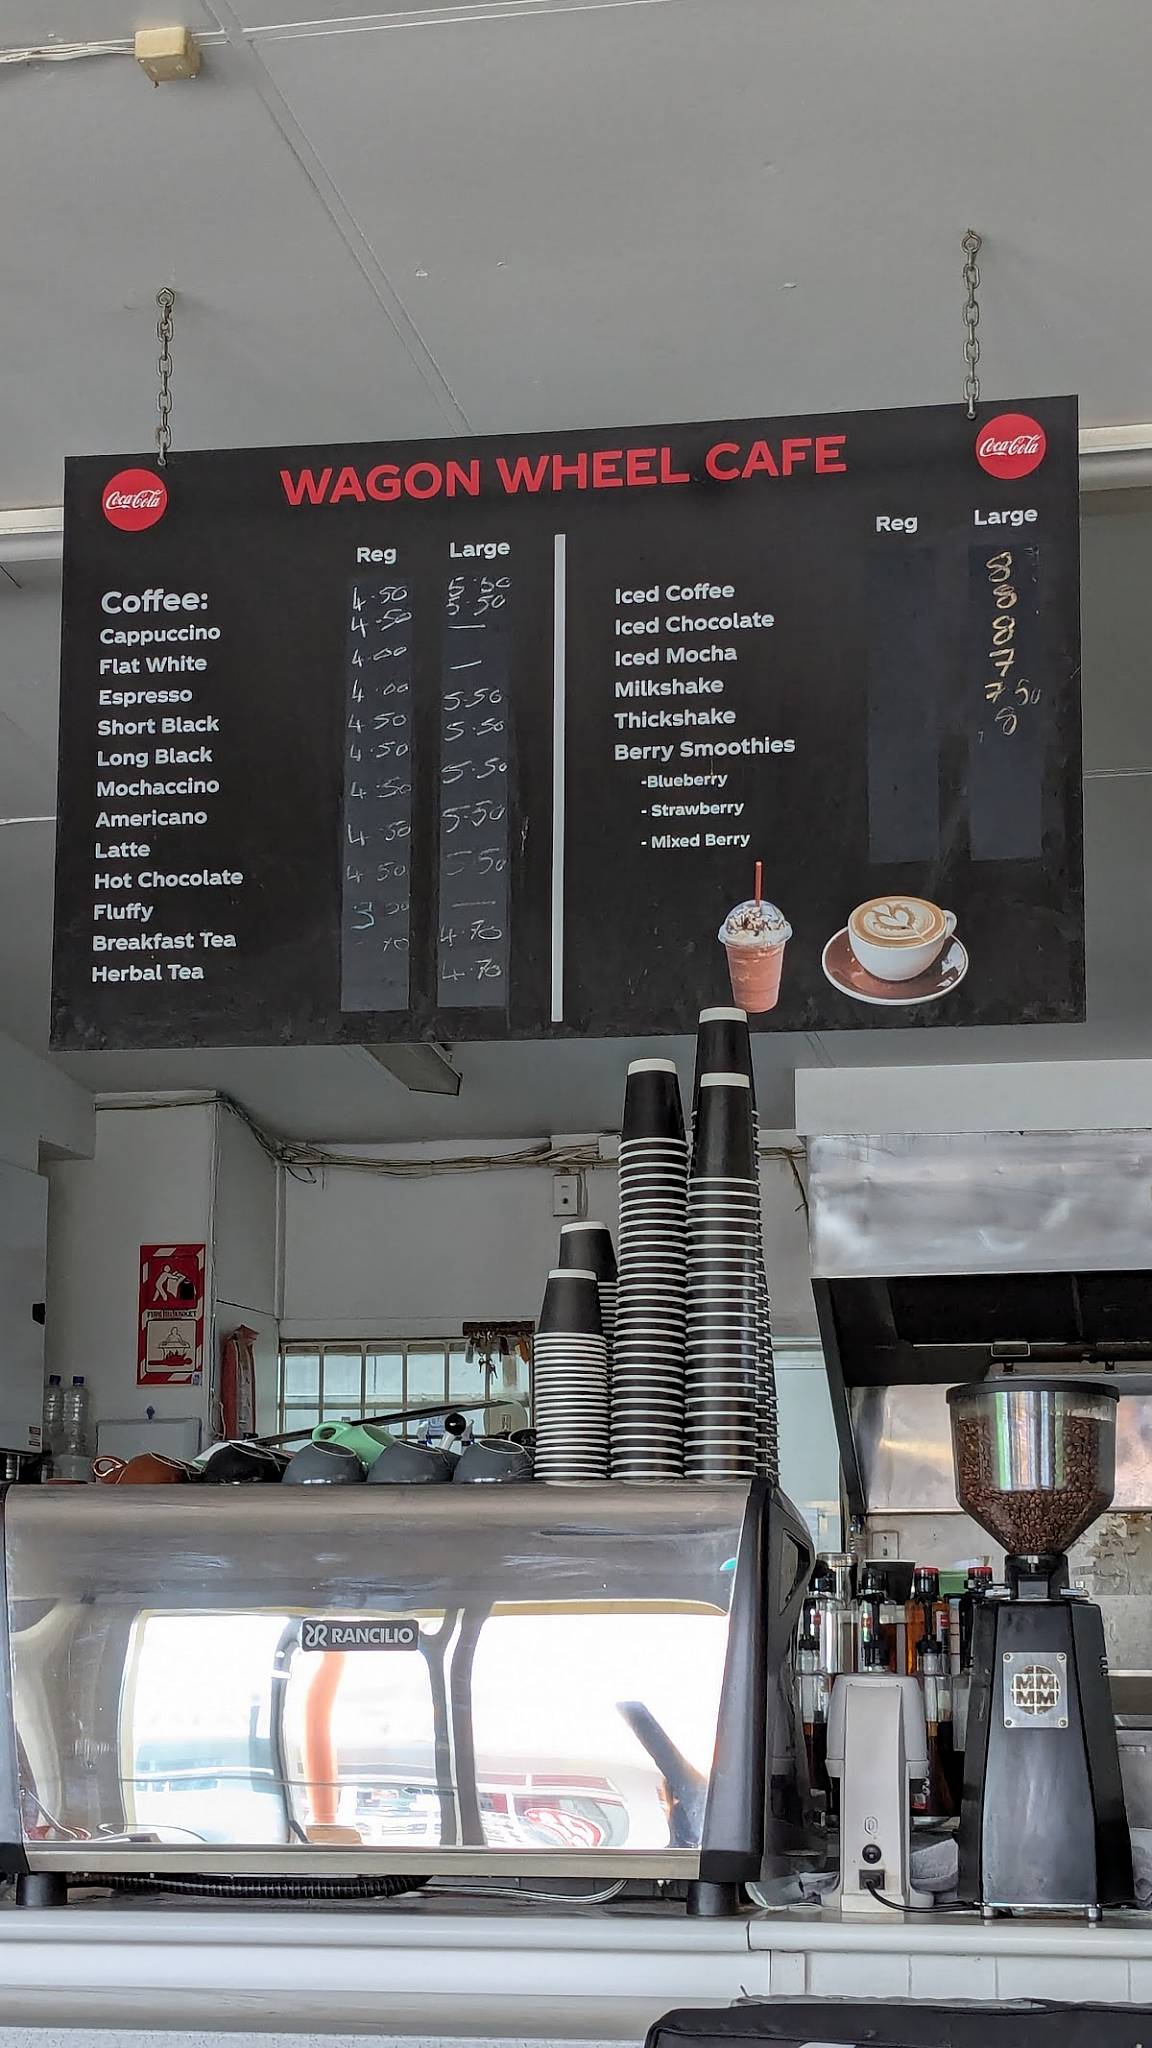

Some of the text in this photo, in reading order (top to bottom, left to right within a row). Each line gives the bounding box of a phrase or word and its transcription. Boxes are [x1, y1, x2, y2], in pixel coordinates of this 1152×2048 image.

[279, 435, 847, 506] WAGON WHEEL CAFE
[876, 515, 918, 534] Reg
[974, 508, 1039, 527] Large
[356, 546, 398, 565] Reg
[449, 541, 511, 560] Large
[101, 588, 208, 614] Coffee:
[615, 582, 735, 605] Iced Coffee
[615, 611, 775, 636] Iced Chocolate
[992, 615, 1016, 646] 8
[99, 624, 221, 647] Cappuccino
[99, 655, 208, 675] Flat White
[615, 645, 738, 667] Iced Mocha
[989, 648, 1015, 678] 7
[614, 677, 724, 698] Milkshake
[99, 689, 193, 708] Espresso
[97, 715, 220, 736] Short Black
[614, 707, 736, 730] Thickshake
[97, 746, 213, 768] Long Black
[614, 736, 796, 762] Berry Smoothies
[96, 777, 220, 797] Mochaccino
[95, 809, 208, 828] Americano
[651, 801, 745, 817] Strawberry
[95, 841, 151, 859] Latte
[651, 834, 701, 849] Mixed
[705, 833, 751, 848] Berry
[94, 868, 244, 890] Hot Chocolate
[93, 902, 154, 923] Fluffy
[92, 931, 237, 952] Breakfast Tea
[91, 963, 205, 983] Herbal Tea
[331, 1628, 414, 1643] RANCILIO
